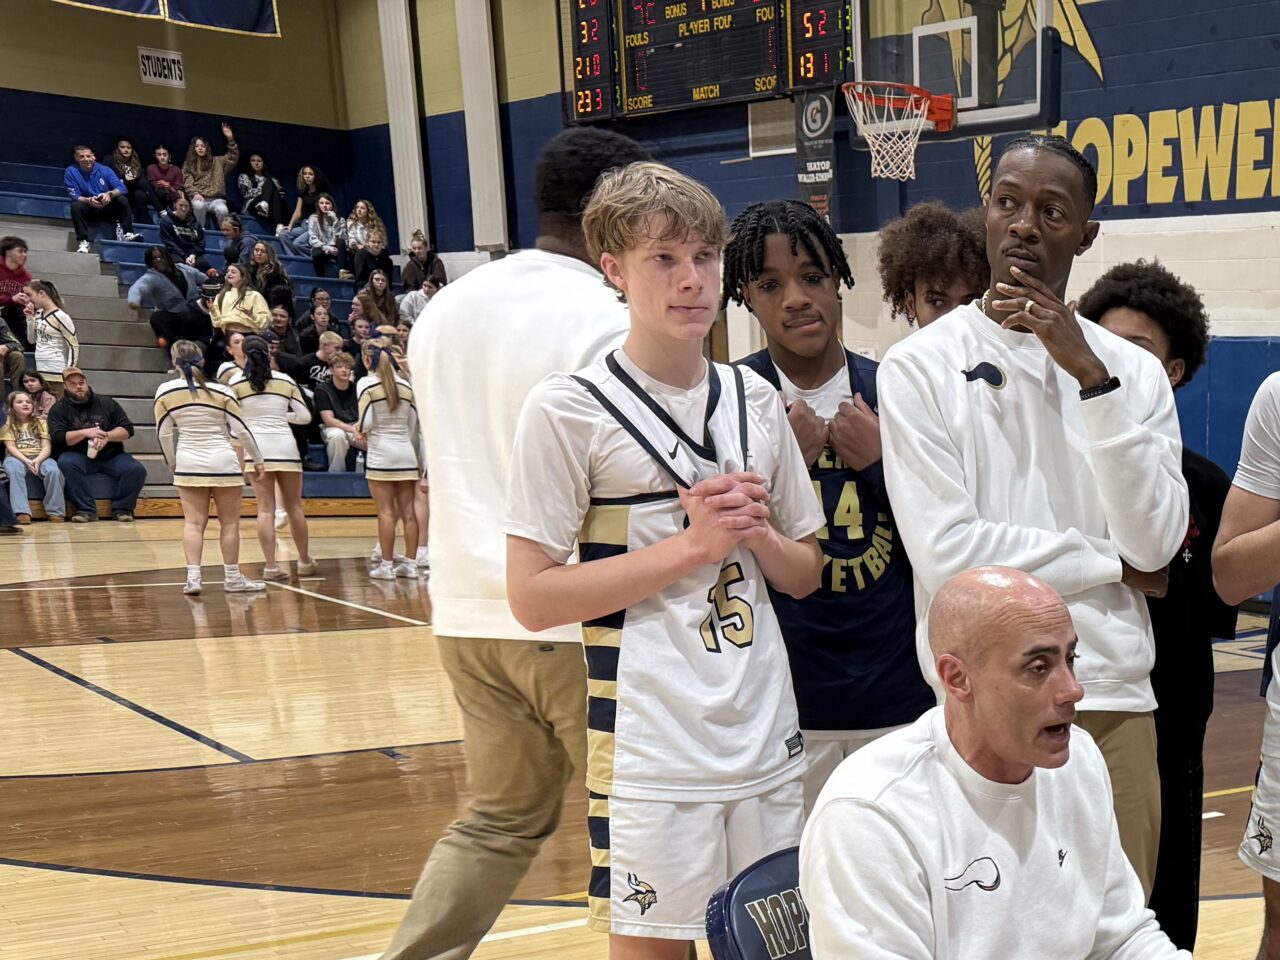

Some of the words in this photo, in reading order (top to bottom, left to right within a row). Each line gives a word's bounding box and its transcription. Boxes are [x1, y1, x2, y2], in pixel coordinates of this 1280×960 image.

[665, 3, 688, 19] BONUS
[626, 32, 649, 47] FOULS
[141, 54, 183, 81] STUDENTS
[692, 84, 720, 100] MATCH
[628, 95, 653, 110] SCORE
